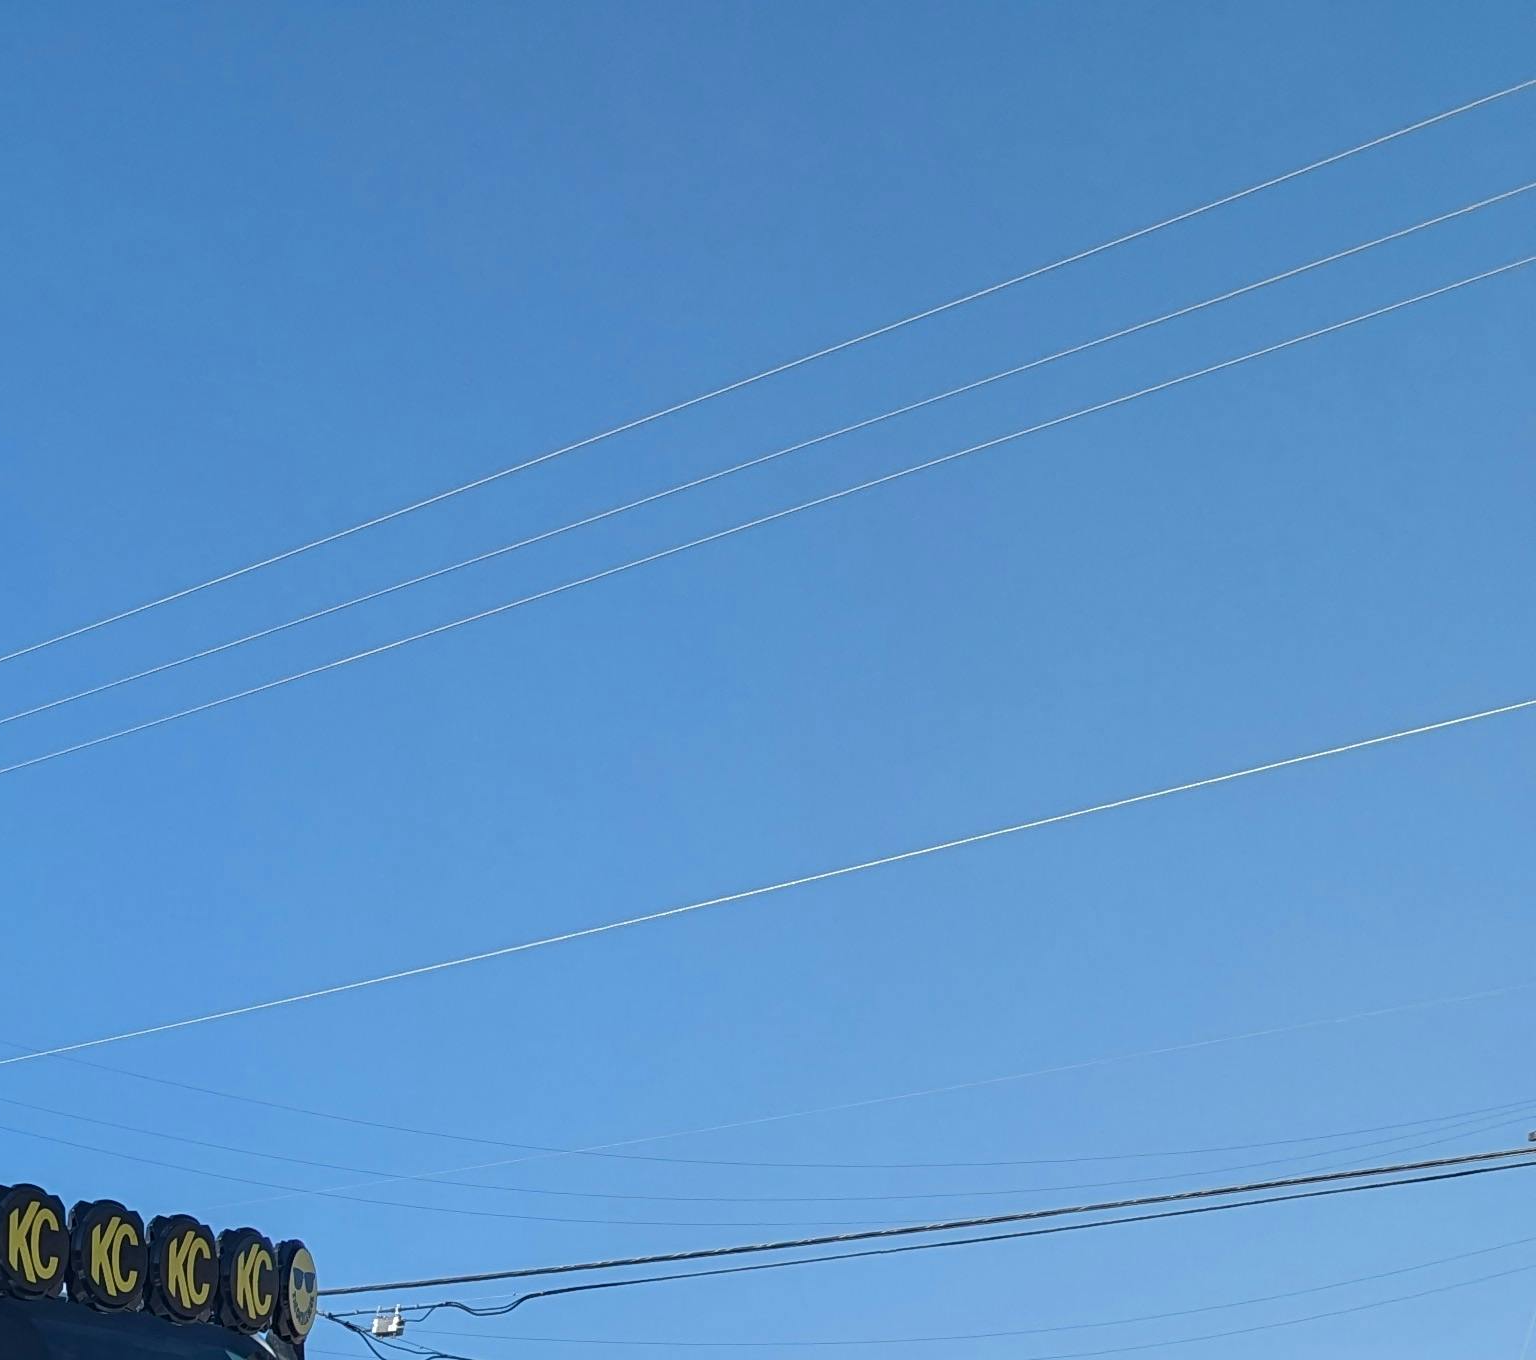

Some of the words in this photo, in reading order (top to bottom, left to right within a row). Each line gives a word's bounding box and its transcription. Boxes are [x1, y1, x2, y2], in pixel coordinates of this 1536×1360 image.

[7, 1200, 60, 1283] KC
[90, 1216, 139, 1296] KC
[167, 1230, 212, 1309] KC
[235, 1243, 272, 1318] KC
